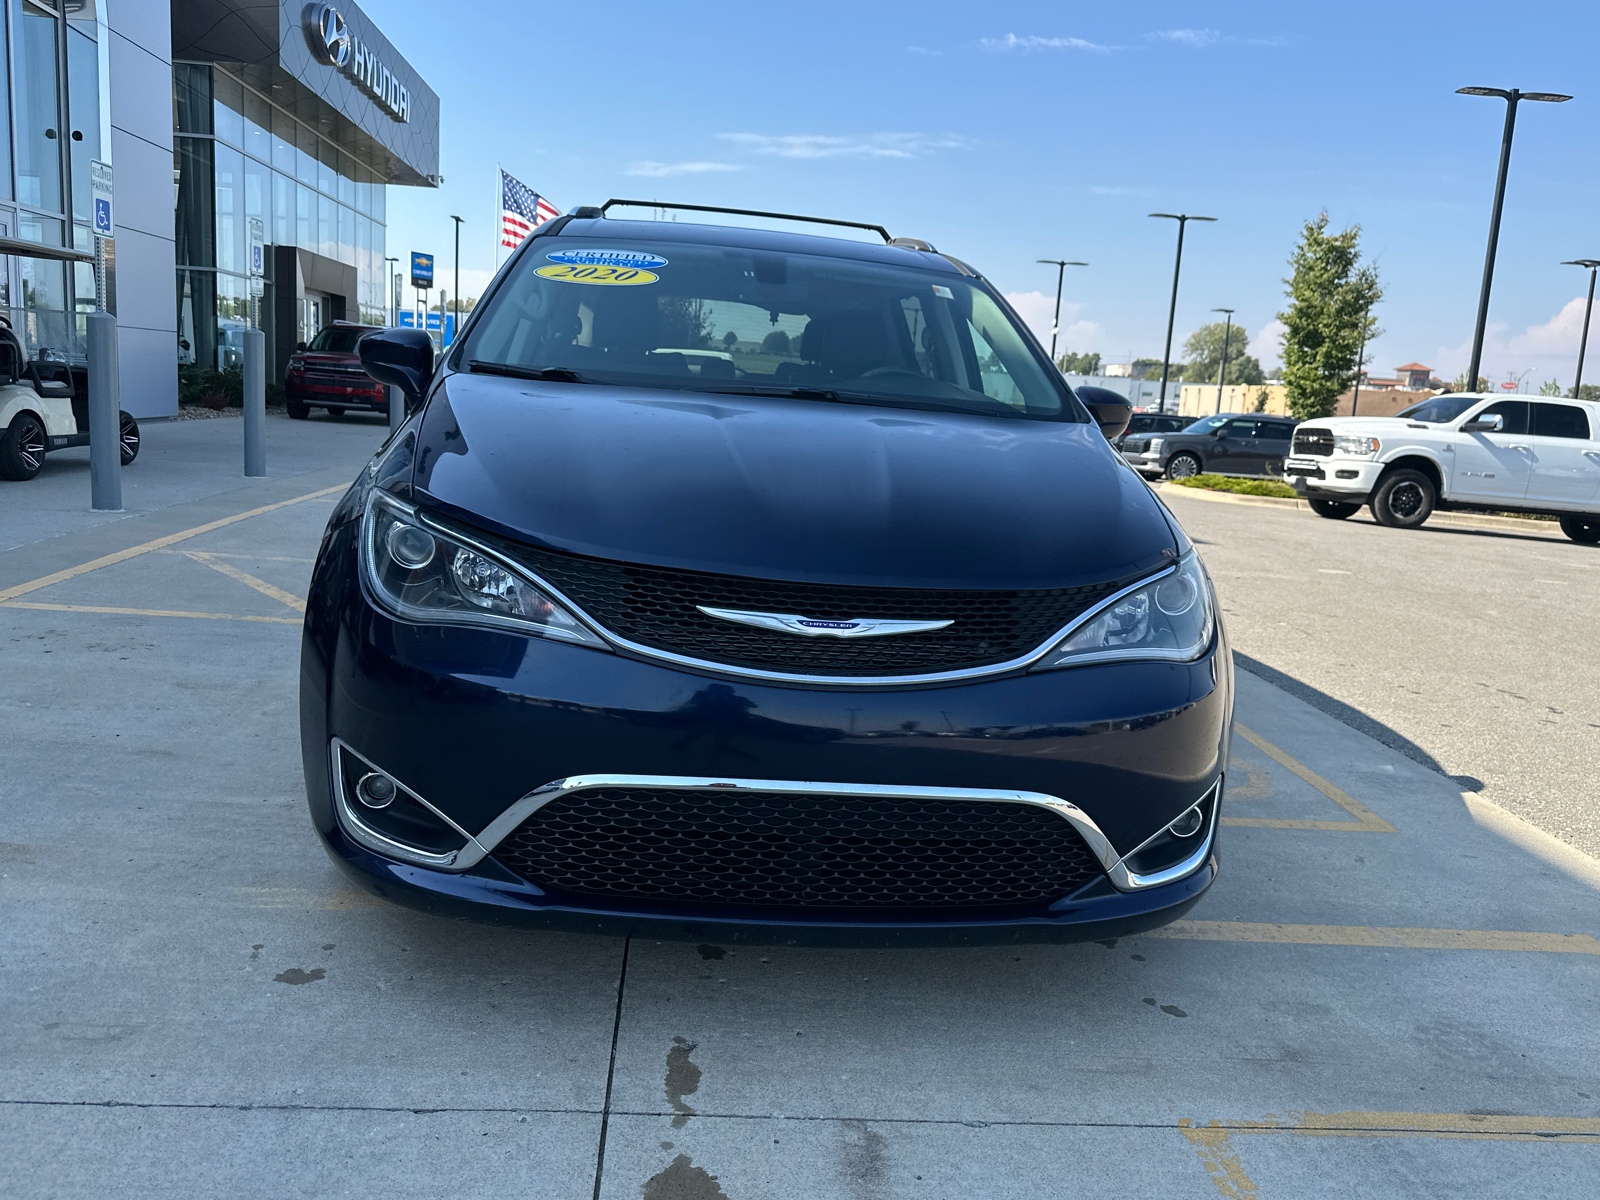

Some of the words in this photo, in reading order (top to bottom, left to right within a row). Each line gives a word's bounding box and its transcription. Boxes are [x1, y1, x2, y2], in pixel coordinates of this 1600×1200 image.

[354, 36, 410, 123] HYUNDAI
[92, 166, 112, 182] RESERVED
[92, 180, 112, 195] PARKING
[562, 250, 656, 261] CERTIFIED
[550, 266, 639, 281] 2020
